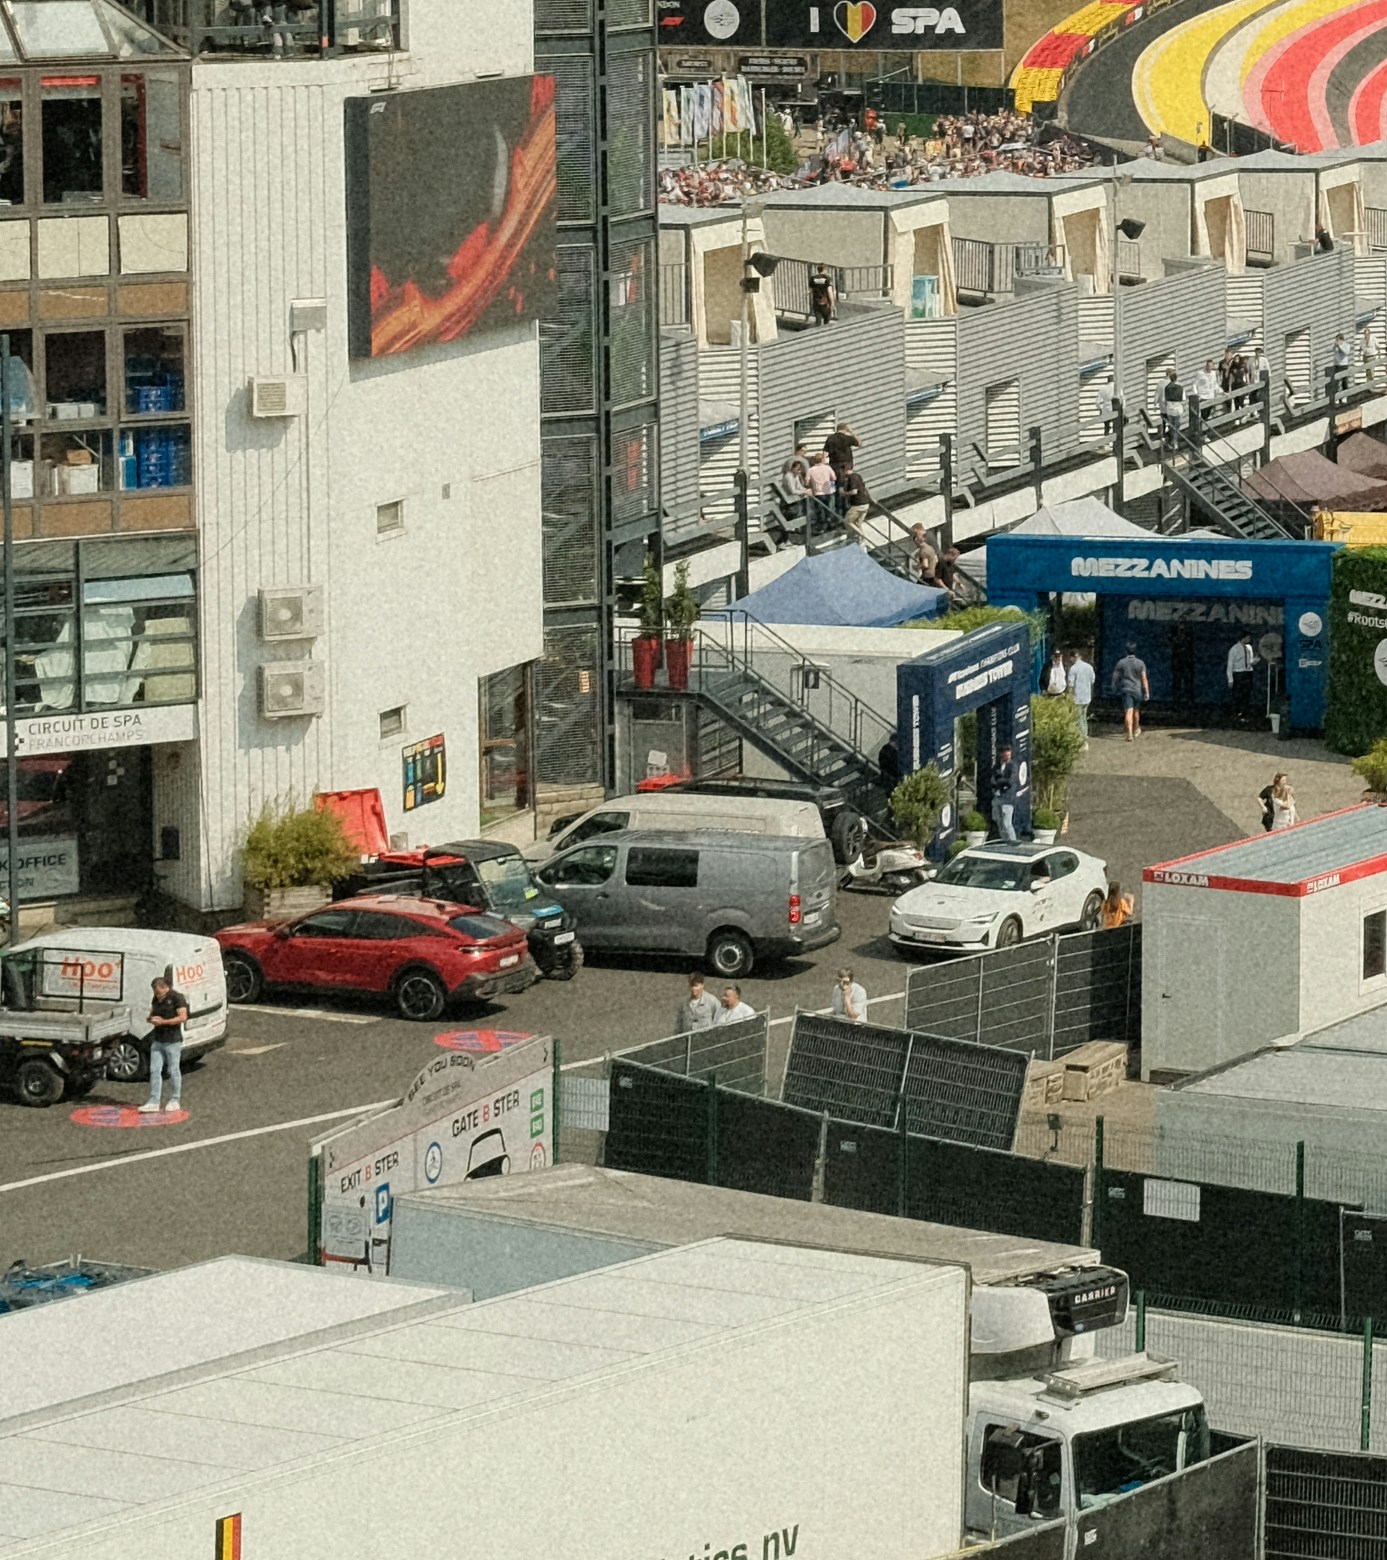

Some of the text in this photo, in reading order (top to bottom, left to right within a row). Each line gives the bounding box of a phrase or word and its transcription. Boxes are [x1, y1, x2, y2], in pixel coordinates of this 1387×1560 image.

[809, 6, 966, 34] I SPA
[1071, 557, 1253, 580] MEZZANINES
[28, 714, 142, 736] CIRCUIT DE SPA
[1164, 873, 1209, 888] LOXAM
[1314, 873, 1341, 894] LOXAM
[428, 1058, 448, 1076] YOU
[452, 1108, 480, 1138] GATE
[483, 1104, 490, 1123] B
[493, 1089, 520, 1118] STER
[340, 1151, 399, 1194] EXIT B STER
[1075, 1286, 1116, 1304] CARRIER
